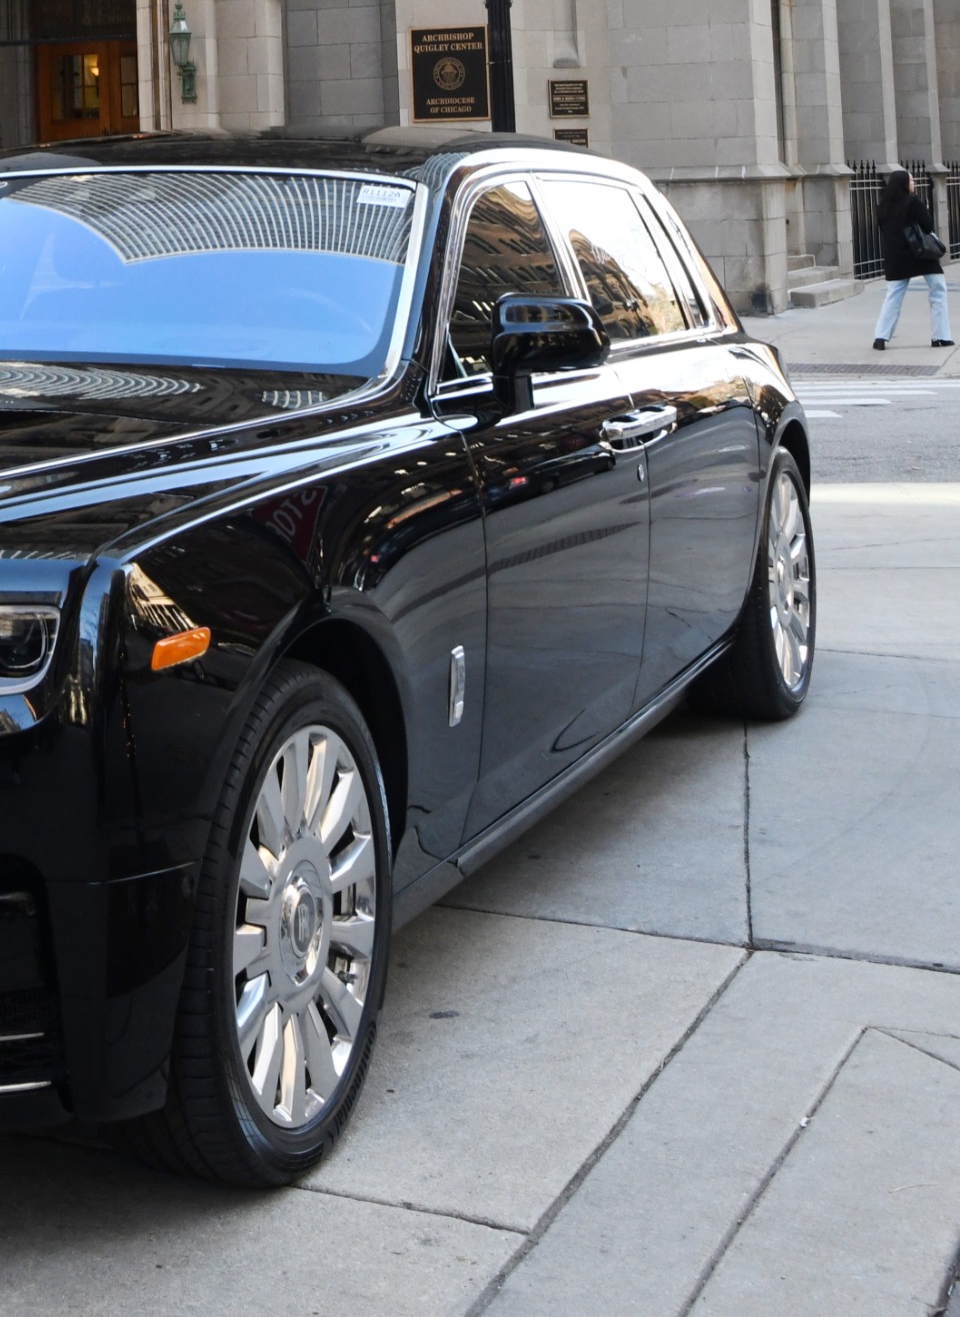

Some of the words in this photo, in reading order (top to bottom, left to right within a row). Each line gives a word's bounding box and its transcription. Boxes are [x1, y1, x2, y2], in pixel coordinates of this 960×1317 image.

[422, 32, 474, 42] ARCHBISHOP
[414, 44, 450, 54] QUIGLEY
[450, 42, 483, 51] CENTER
[426, 97, 475, 105] ARCHDIOCESE
[430, 106, 440, 114] OF
[440, 105, 472, 113] CHICAGO
